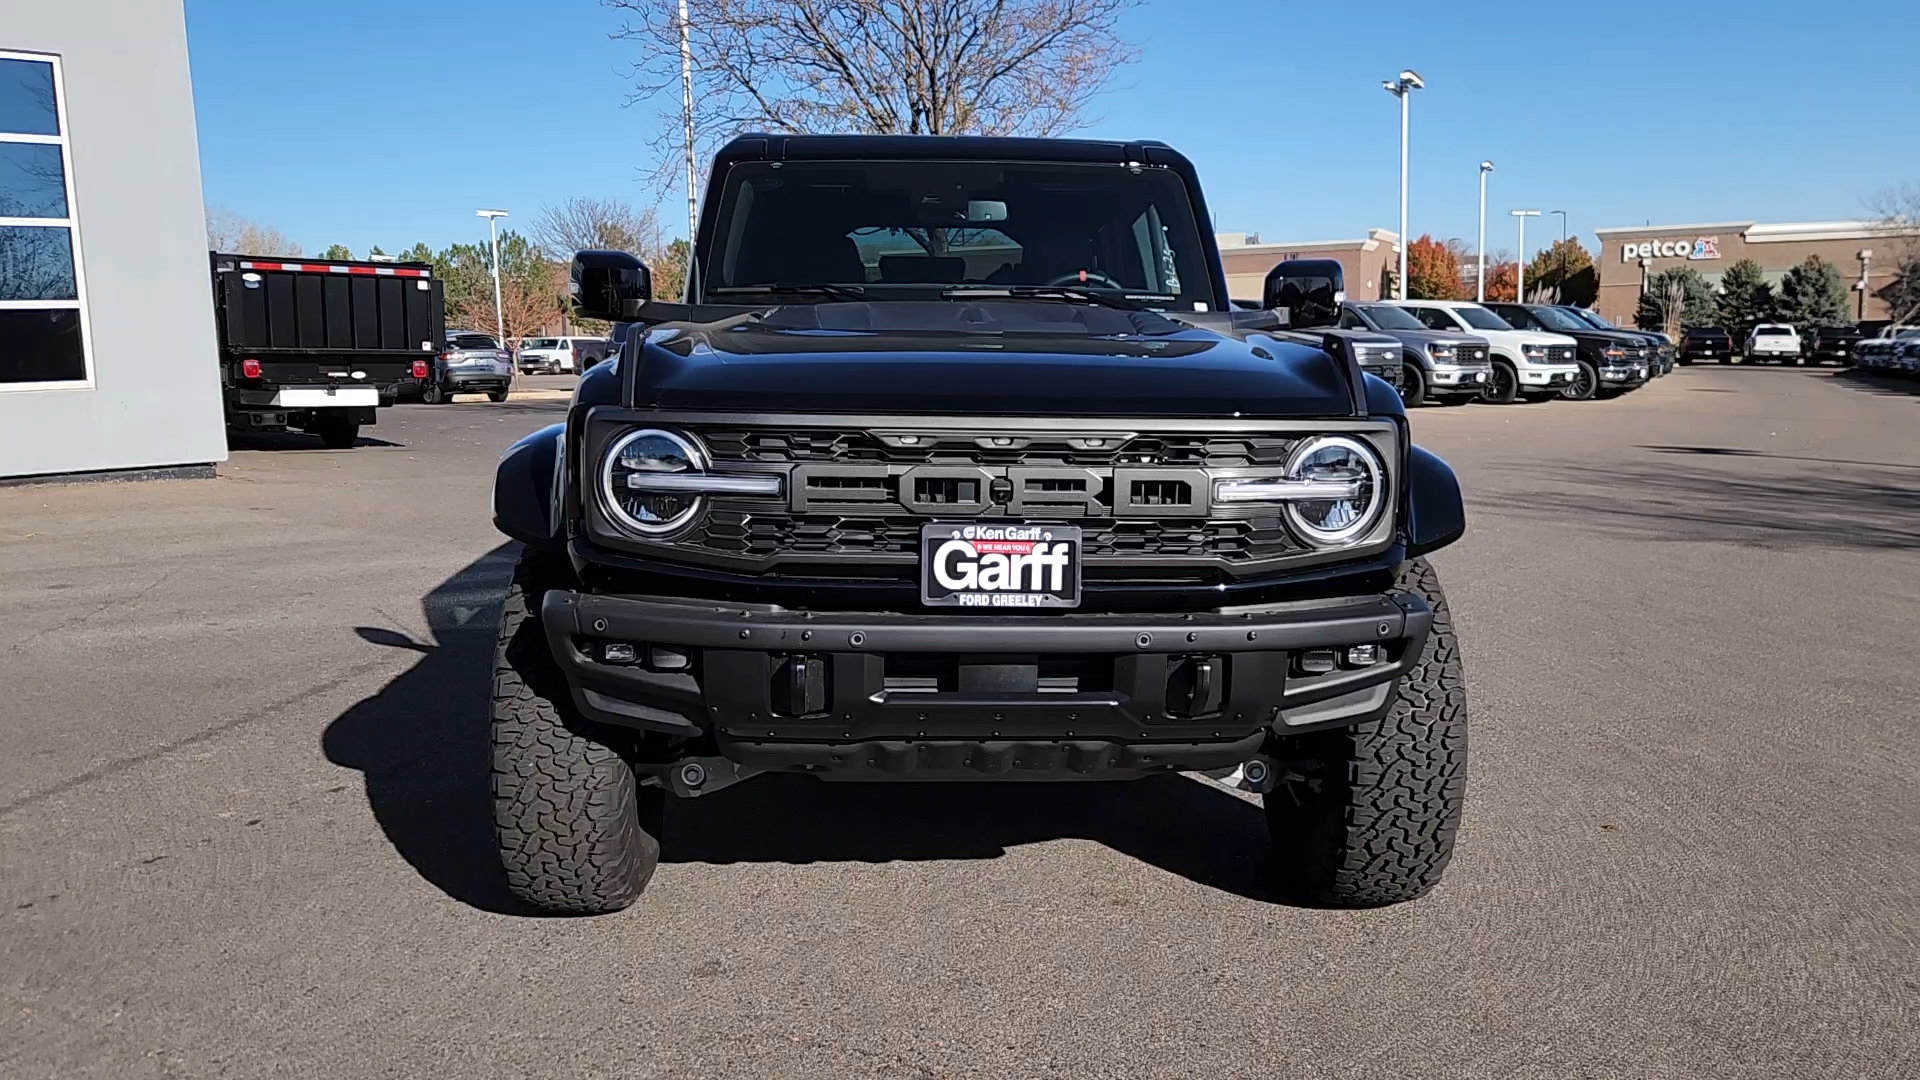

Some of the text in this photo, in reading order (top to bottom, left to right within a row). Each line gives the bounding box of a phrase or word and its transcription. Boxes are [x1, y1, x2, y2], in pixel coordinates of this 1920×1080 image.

[1623, 239, 1691, 263] petco
[791, 464, 1209, 516] FORD
[976, 526, 1004, 540] Ken
[1005, 526, 1041, 540] Garff
[983, 543, 1027, 552] WE HEAR YOU
[933, 540, 1069, 591] Garff
[959, 594, 1043, 607] FORD GREELEY
